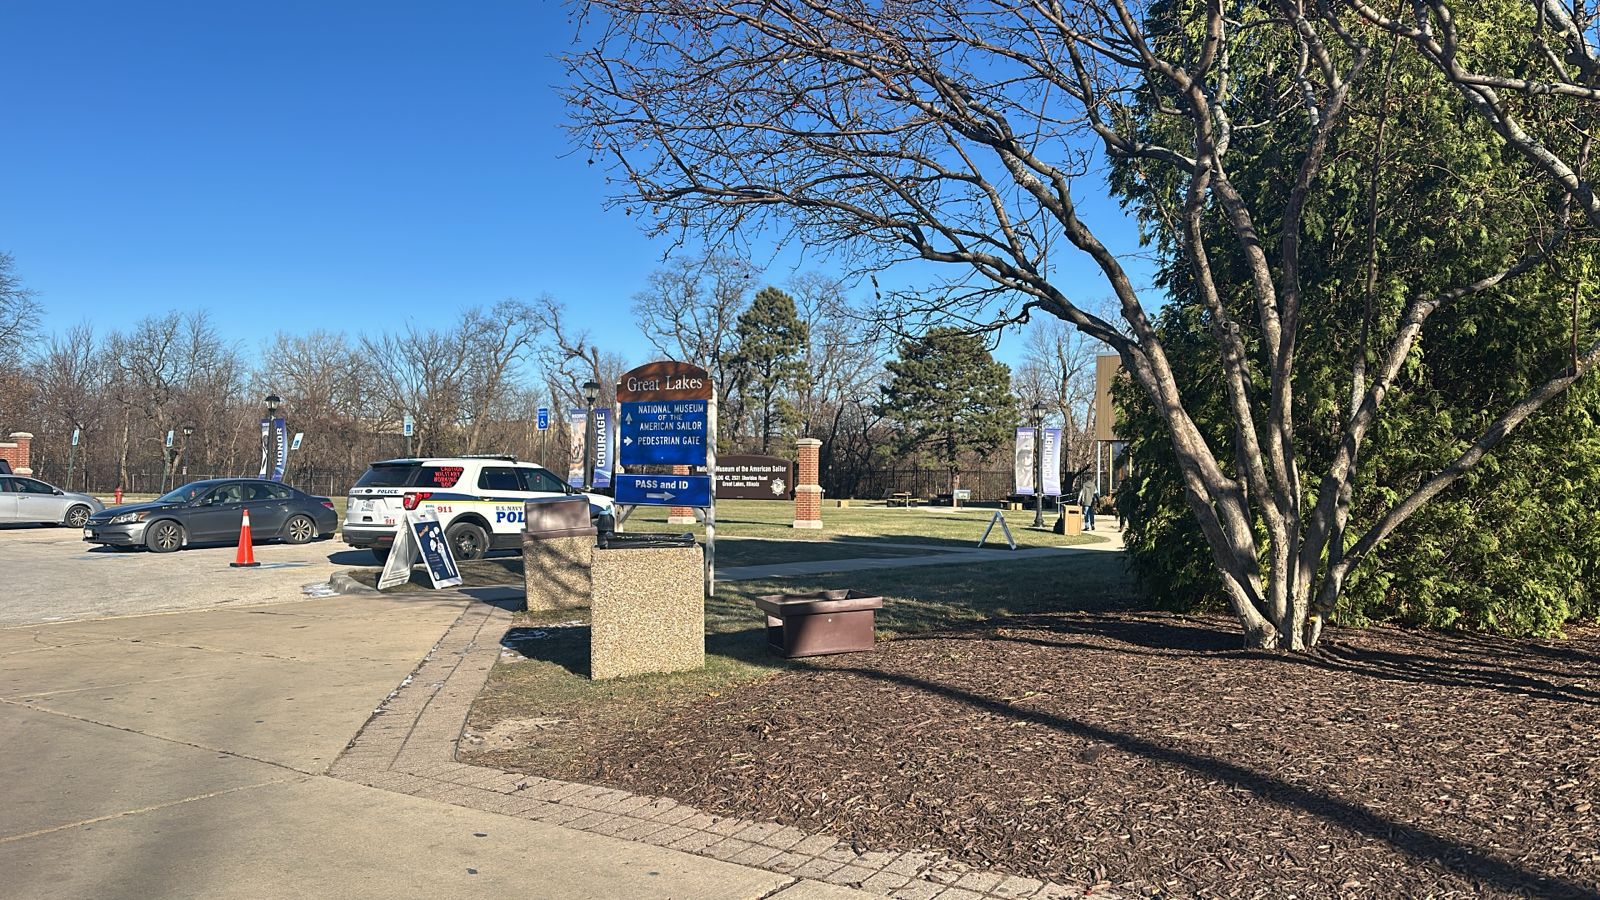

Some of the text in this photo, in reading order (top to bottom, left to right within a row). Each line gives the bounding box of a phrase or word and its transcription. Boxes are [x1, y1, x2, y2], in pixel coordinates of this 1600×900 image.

[627, 374, 703, 392] Great Lakes
[638, 403, 704, 414] NATIONAL MUSEUM
[639, 421, 702, 431] AMERICAN SAILOR
[596, 413, 606, 468] COURAGE
[637, 436, 700, 446] PEDESTRIAN GATE
[276, 427, 284, 466] HONOR
[635, 480, 688, 490] PASS and ID
[496, 511, 526, 523] POL
